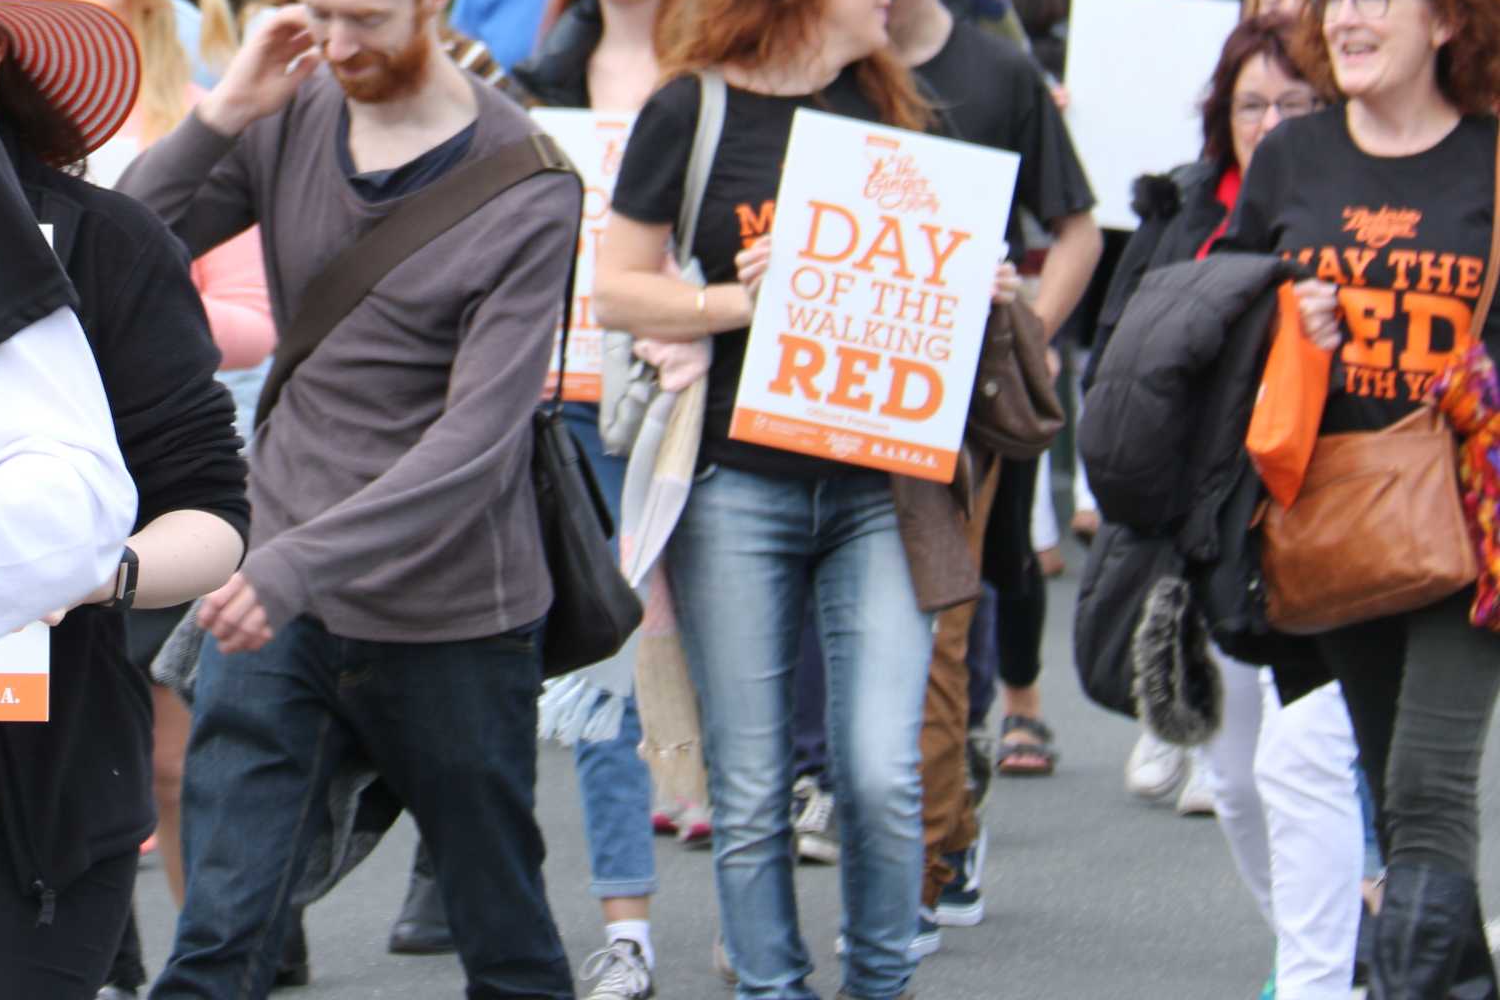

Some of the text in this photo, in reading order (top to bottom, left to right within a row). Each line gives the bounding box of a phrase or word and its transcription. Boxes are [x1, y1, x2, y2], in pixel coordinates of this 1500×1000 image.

[797, 200, 971, 286] DAY
[1388, 250, 1485, 298] THE
[789, 266, 958, 330] OF THE
[784, 302, 951, 362] WALKING
[1337, 287, 1475, 375] ED
[768, 335, 945, 422] RED
[1344, 366, 1397, 400] ITH
